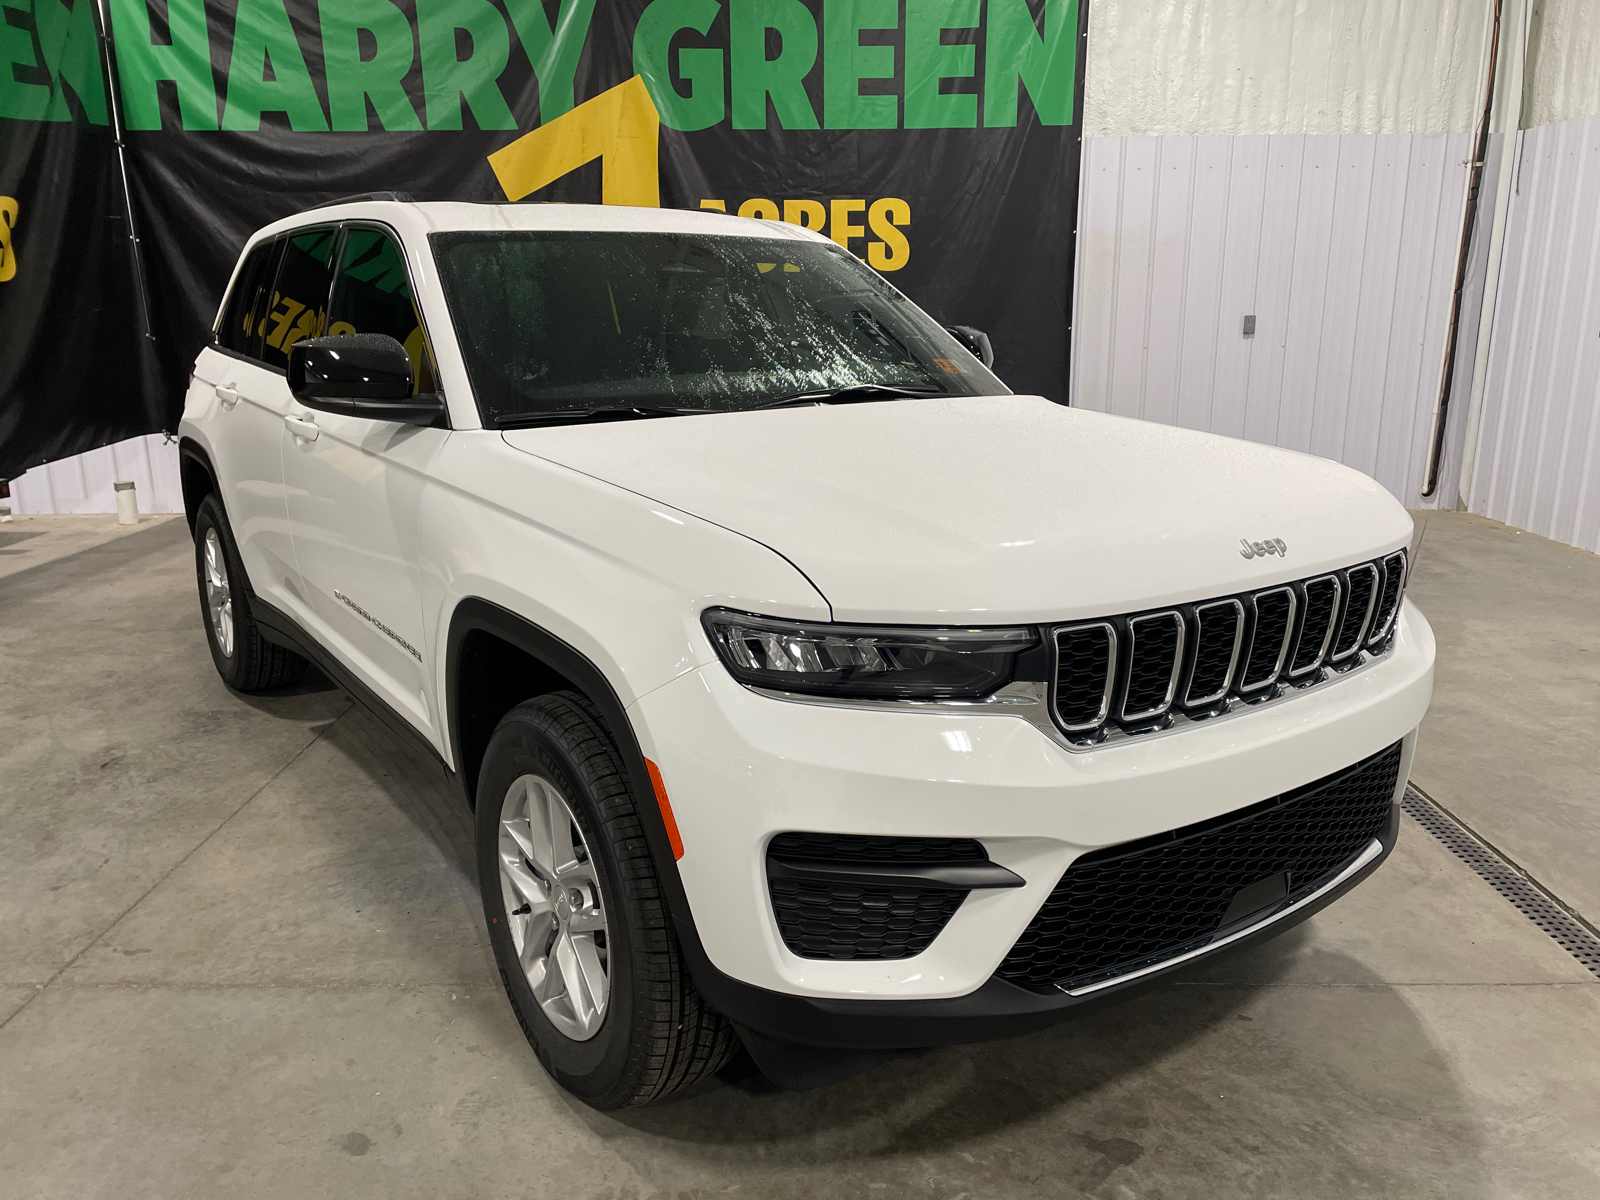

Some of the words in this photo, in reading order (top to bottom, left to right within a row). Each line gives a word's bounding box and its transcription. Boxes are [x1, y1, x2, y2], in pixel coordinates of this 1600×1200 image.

[109, 0, 598, 131] HARRY
[633, 0, 1078, 131] GREEN
[1239, 537, 1287, 560] Jeep
